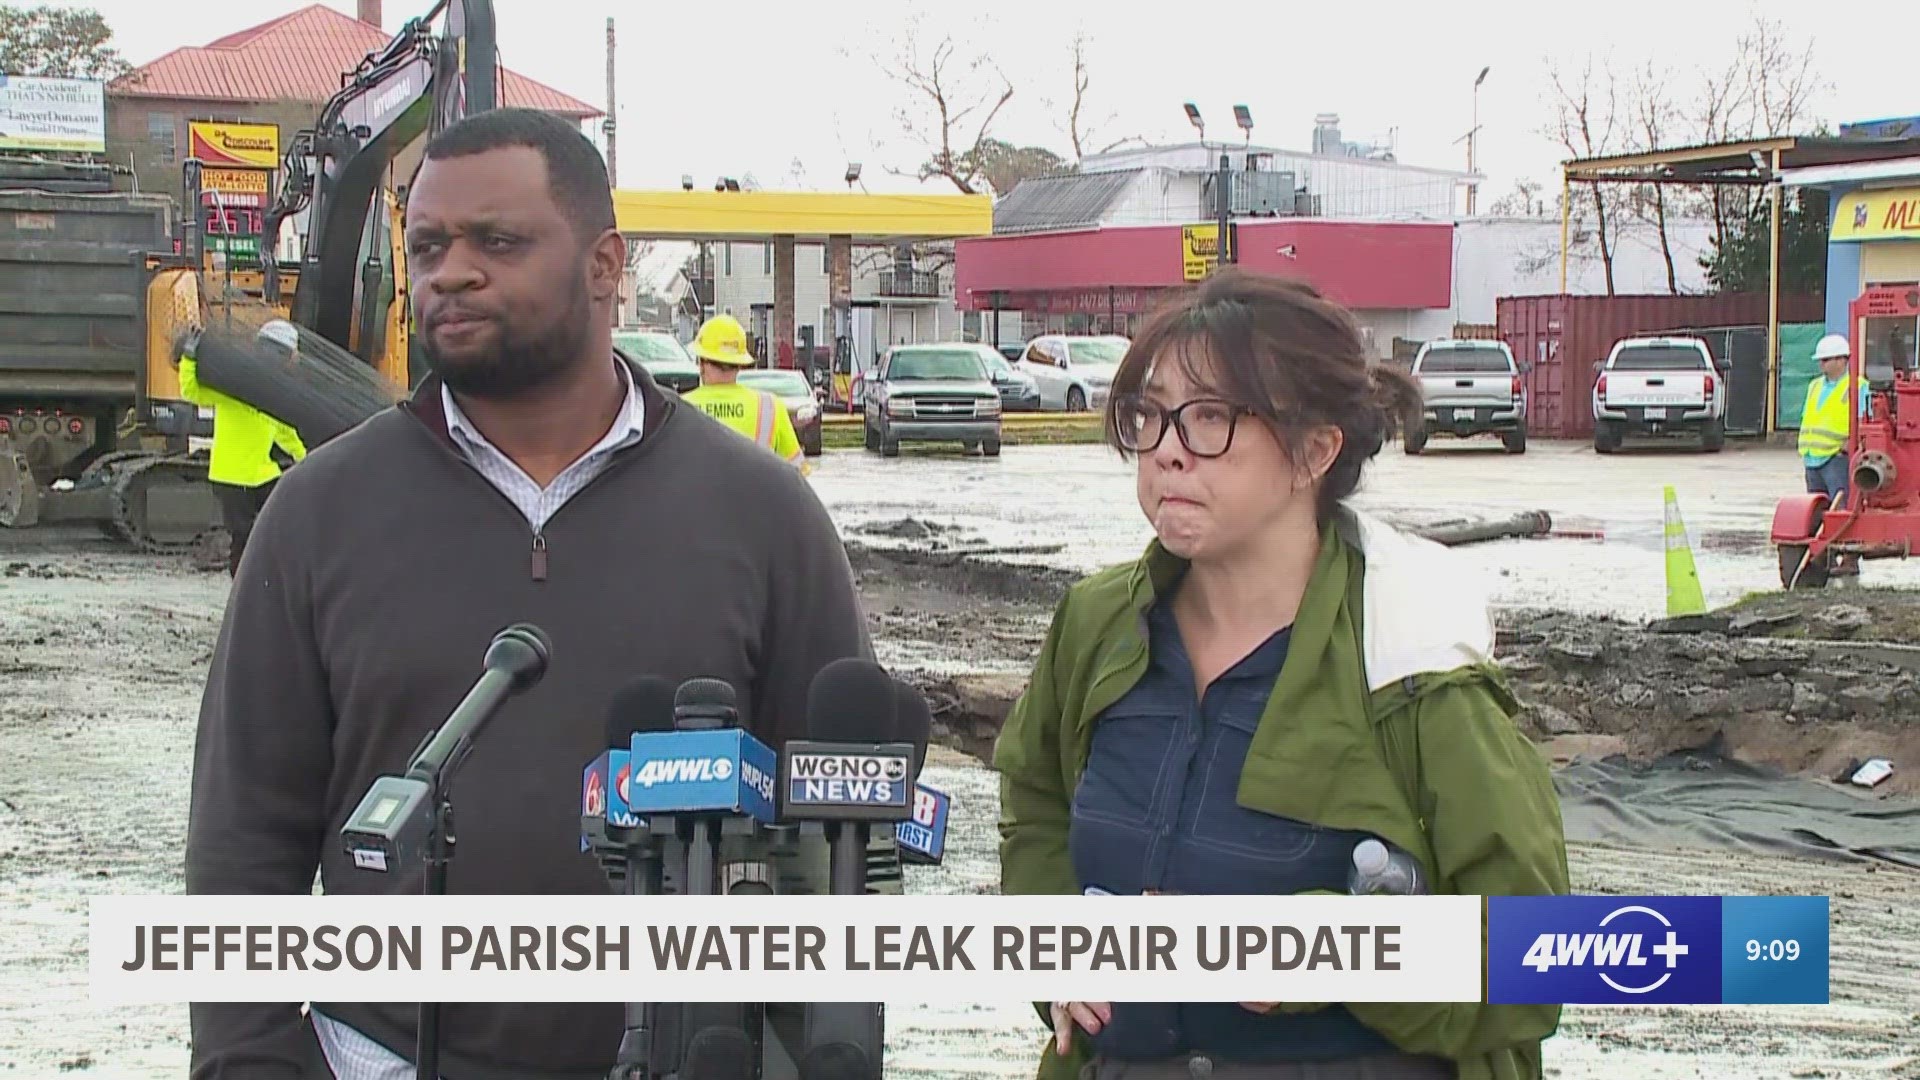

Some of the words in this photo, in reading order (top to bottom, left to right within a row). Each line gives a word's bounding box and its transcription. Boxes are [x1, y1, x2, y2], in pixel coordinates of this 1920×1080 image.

[373, 76, 411, 119] HYUNDAI
[203, 171, 232, 181] HOT
[234, 172, 266, 182] FOOD
[1883, 200, 1920, 230] MI
[216, 239, 254, 250] DESEL
[699, 403, 744, 418] EMING
[795, 758, 881, 778] WGNO
[805, 780, 892, 801] NEWS
[898, 822, 929, 849] IRST
